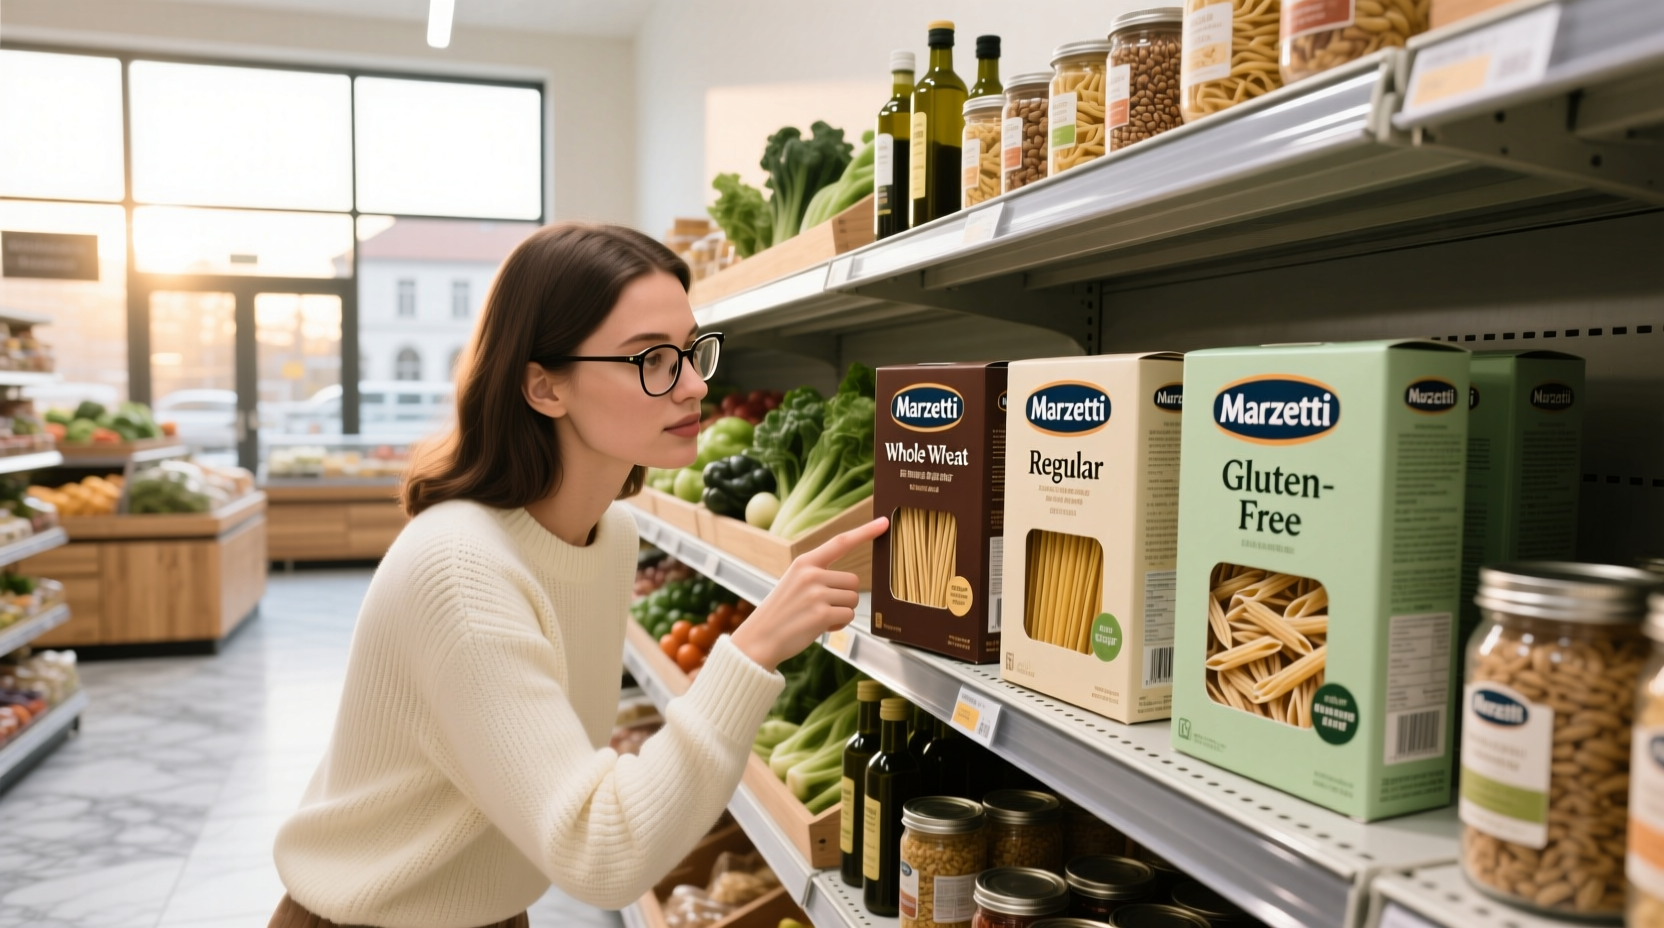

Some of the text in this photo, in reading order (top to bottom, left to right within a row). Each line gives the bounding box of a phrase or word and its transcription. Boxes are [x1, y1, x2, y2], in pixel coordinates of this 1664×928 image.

[896, 395, 958, 419] Marzetti
[1031, 395, 1106, 421] Marzetti
[1220, 392, 1331, 427] Marzetti
[885, 442, 926, 464] Whole
[1028, 450, 1104, 484] Regular
[1222, 459, 1335, 499] Gluten-
[1238, 499, 1302, 537] Free
